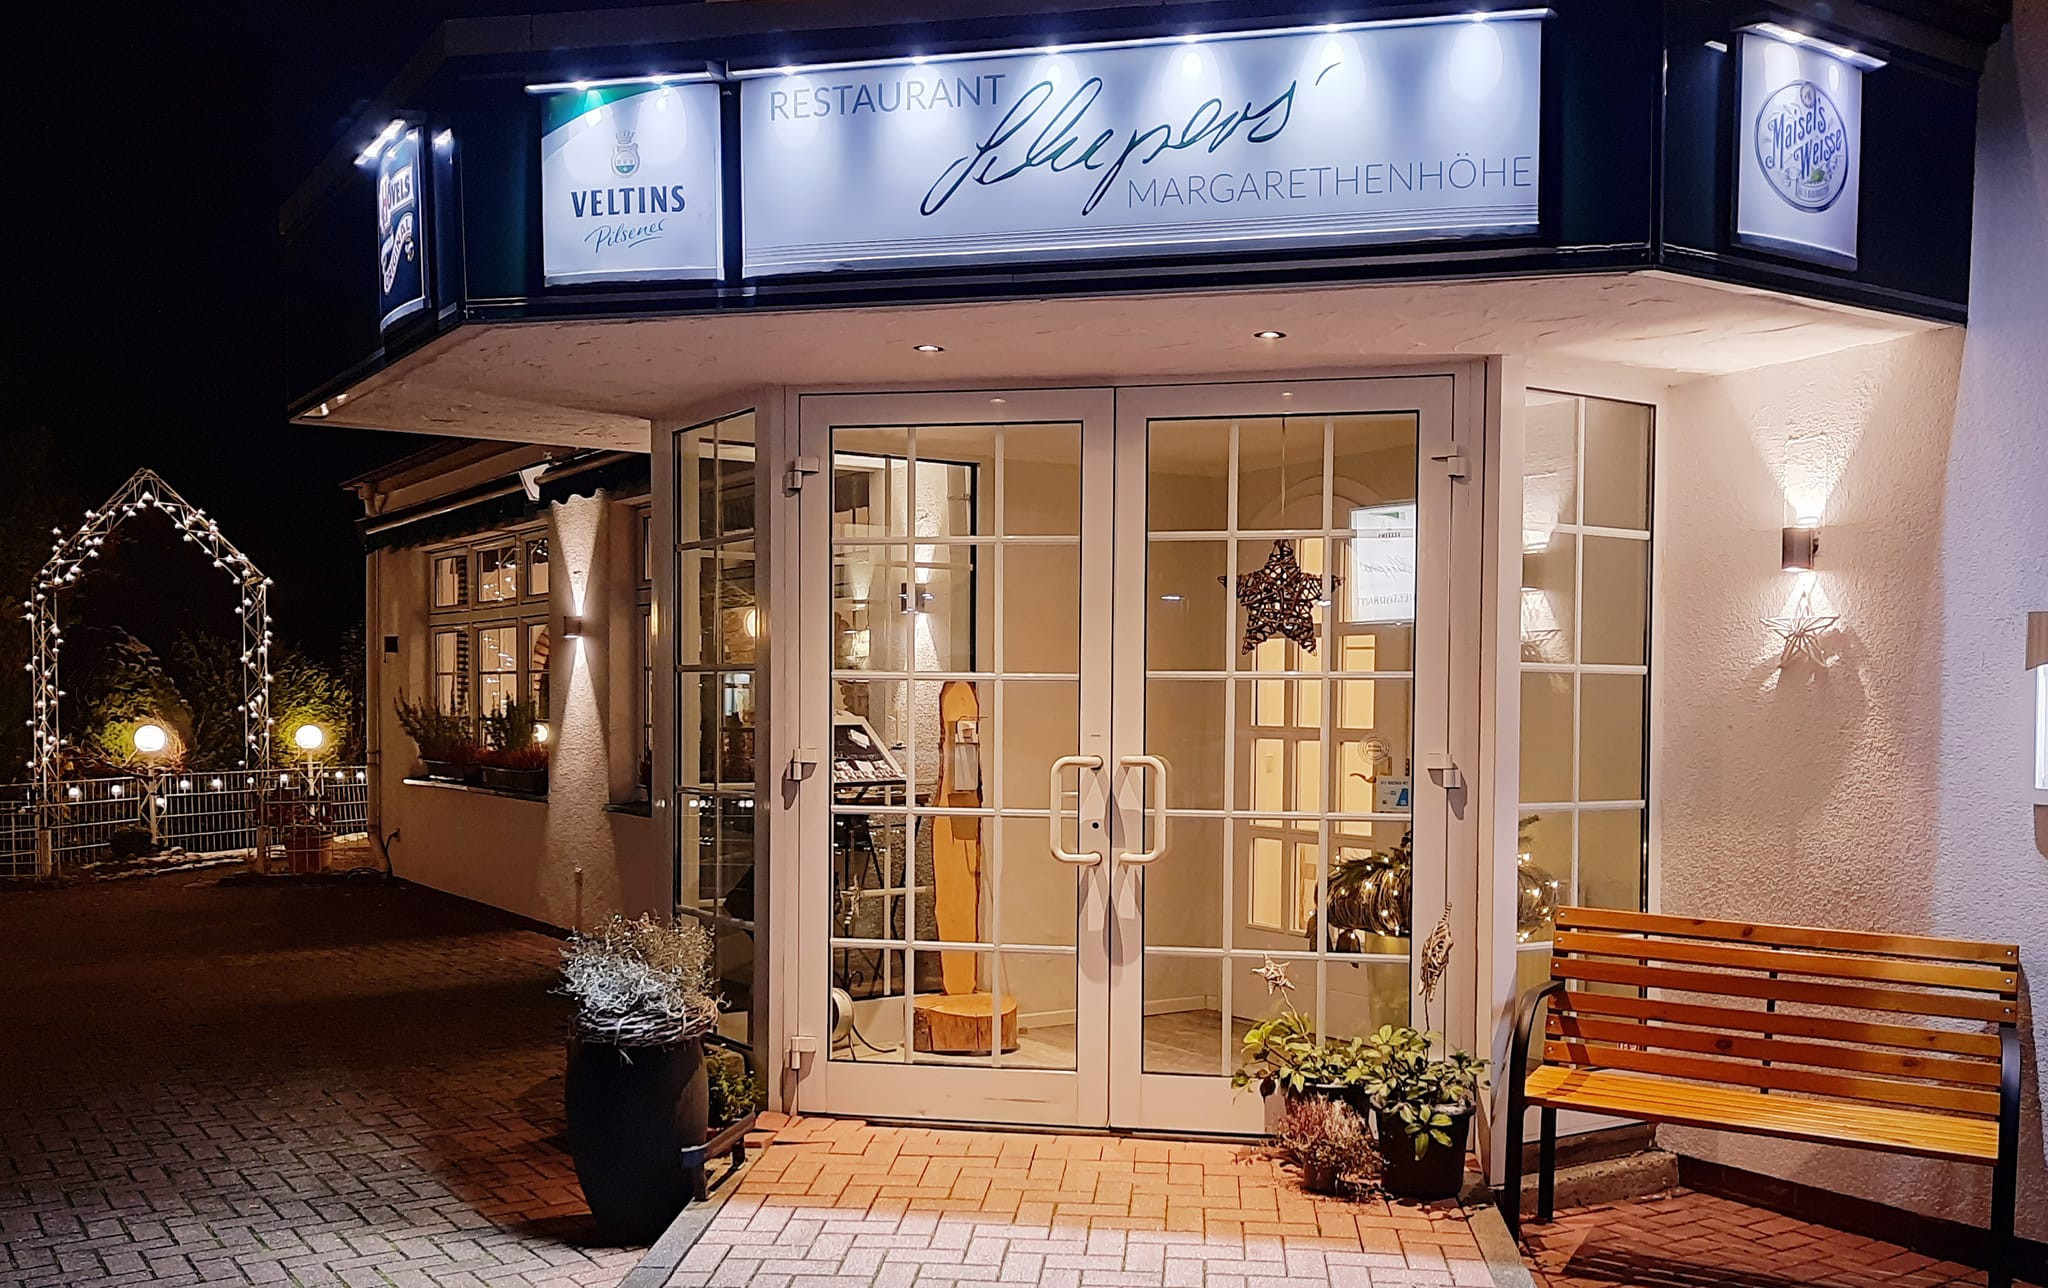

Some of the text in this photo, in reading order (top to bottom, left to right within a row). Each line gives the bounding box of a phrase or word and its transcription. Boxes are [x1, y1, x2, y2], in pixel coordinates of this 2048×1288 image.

[769, 73, 1006, 121] RESTAURANT
[1765, 97, 1827, 170] Maisel's
[1793, 128, 1843, 180] Weisse
[570, 184, 687, 218] VELTINS
[1126, 153, 1534, 209] MARGARETHENHÖHE
[584, 218, 668, 254] Pilsener
